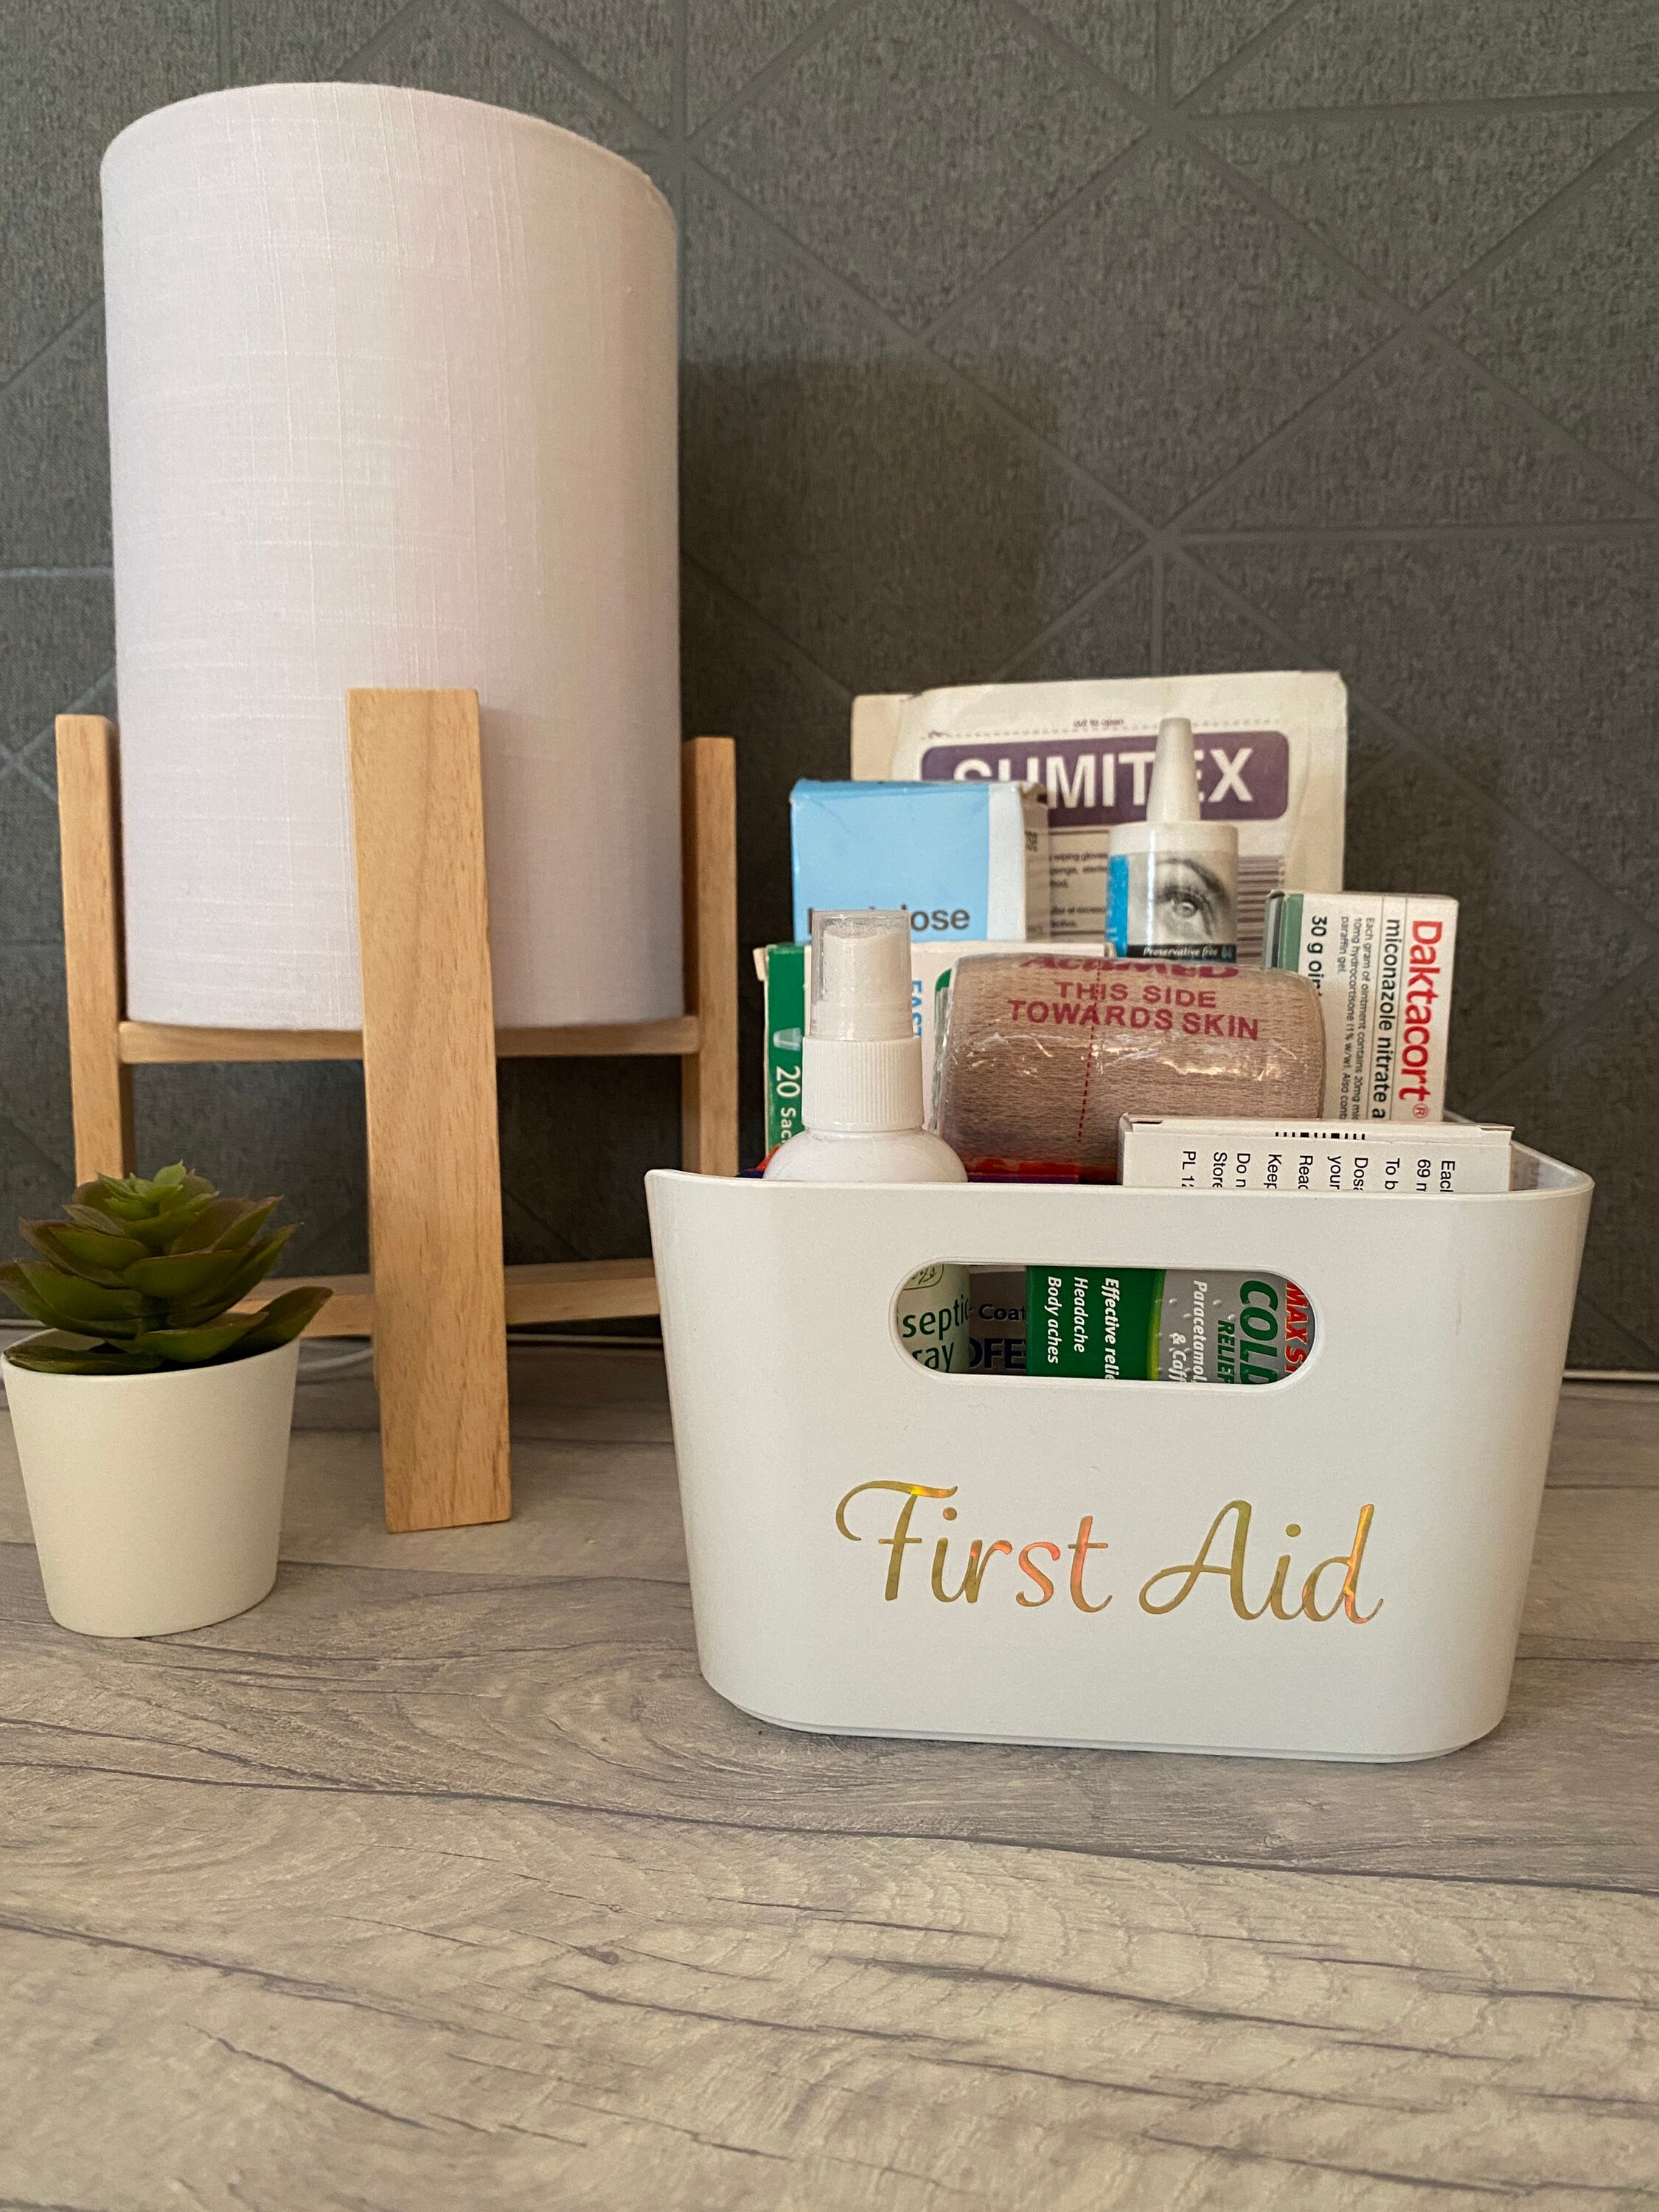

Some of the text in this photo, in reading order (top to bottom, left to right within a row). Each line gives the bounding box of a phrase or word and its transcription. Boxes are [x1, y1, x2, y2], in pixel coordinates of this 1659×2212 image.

[1340, 917, 1349, 954] paraffin
[1351, 918, 1363, 944] 10mg
[1365, 917, 1374, 941] Each
[1307, 915, 1327, 996] 30 g oi
[1362, 971, 1370, 981] of
[1363, 943, 1371, 969] gram
[1378, 919, 1402, 1031] miconazole
[1054, 981, 1217, 1009] THIS SIDE
[1346, 946, 1361, 1021] hydrocortisone
[1007, 999, 1258, 1040] TOWARDS SKIN
[1357, 984, 1369, 1029] ointment
[1355, 1032, 1365, 1073] contains
[1373, 1037, 1394, 1102] nitrate
[1341, 1073, 1351, 1093] Also
[1352, 1076, 1363, 1102] 20mg
[776, 1065, 801, 1143] 20 Sac
[1181, 1151, 1197, 1188] PL 1
[1237, 1153, 1251, 1174] Do
[1327, 1155, 1342, 1190] your
[1353, 1157, 1368, 1191] Dos
[1385, 1158, 1400, 1175] To
[1416, 1159, 1431, 1178] 69
[897, 1294, 970, 1341] septic
[1044, 1276, 1062, 1364] Body aches
[1074, 1276, 1088, 1353] Headache
[1101, 1277, 1120, 1344] Effective
[1192, 1280, 1208, 1382] Paracetamol
[1285, 1280, 1308, 1345] MAX
[1172, 1332, 1186, 1345] &
[1217, 1320, 1235, 1384] RELIEF
[1239, 1280, 1279, 1385] COLD
[835, 1480, 1384, 1624] First Aid
